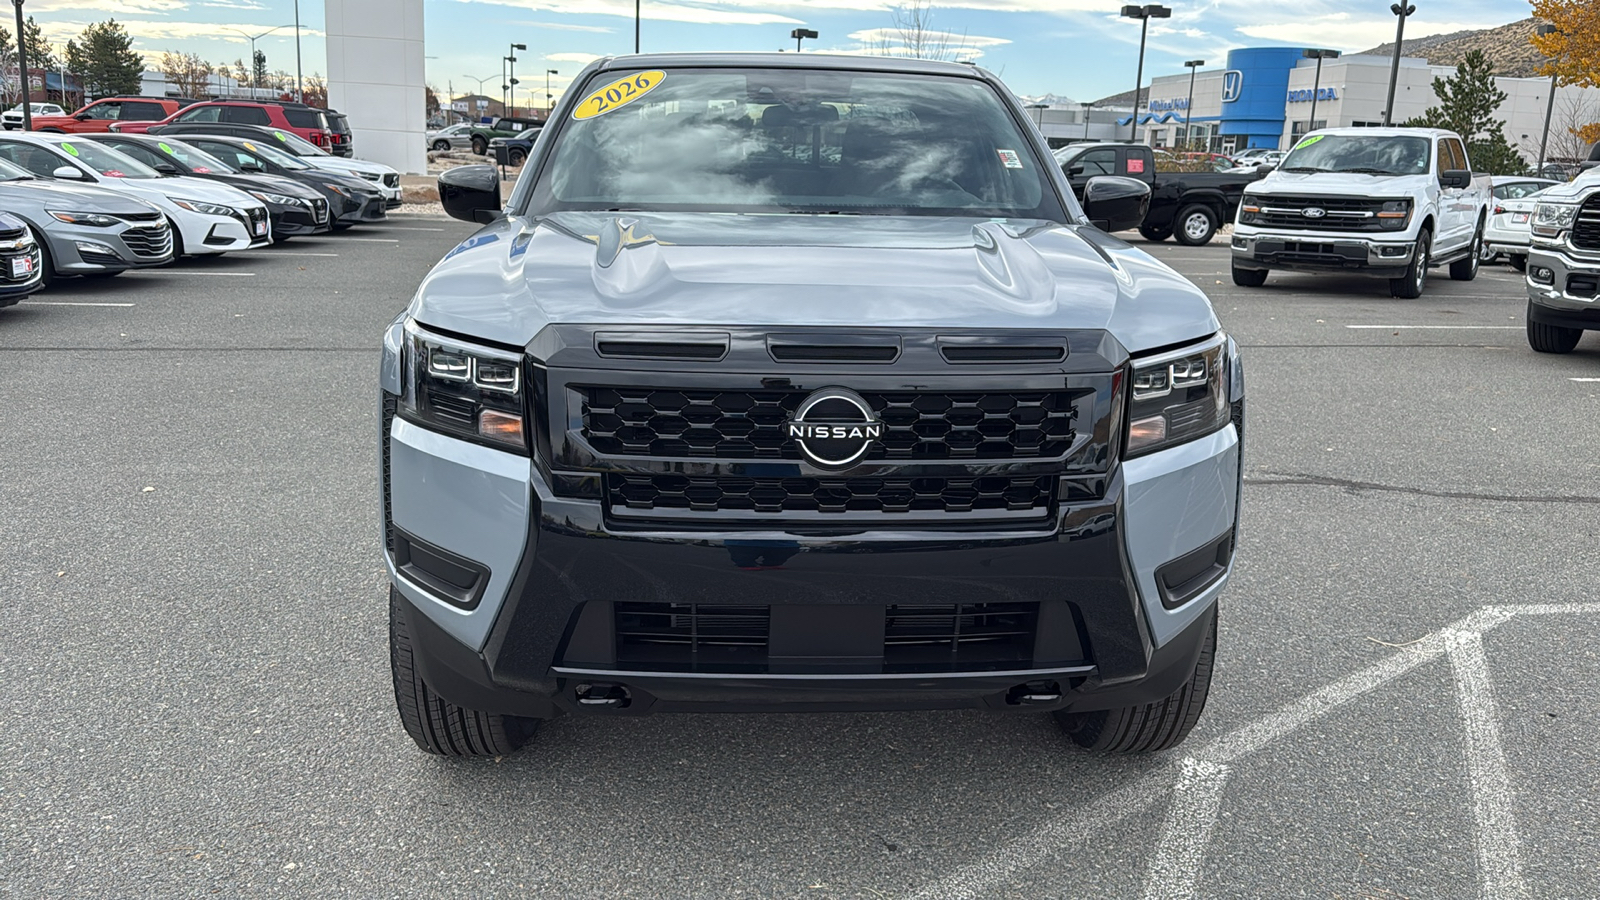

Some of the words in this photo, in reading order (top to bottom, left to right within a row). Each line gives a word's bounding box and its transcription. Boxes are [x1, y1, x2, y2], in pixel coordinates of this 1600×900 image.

[590, 74, 650, 112] 2026
[1288, 88, 1338, 102] HONDA
[789, 425, 880, 439] NISSAN
